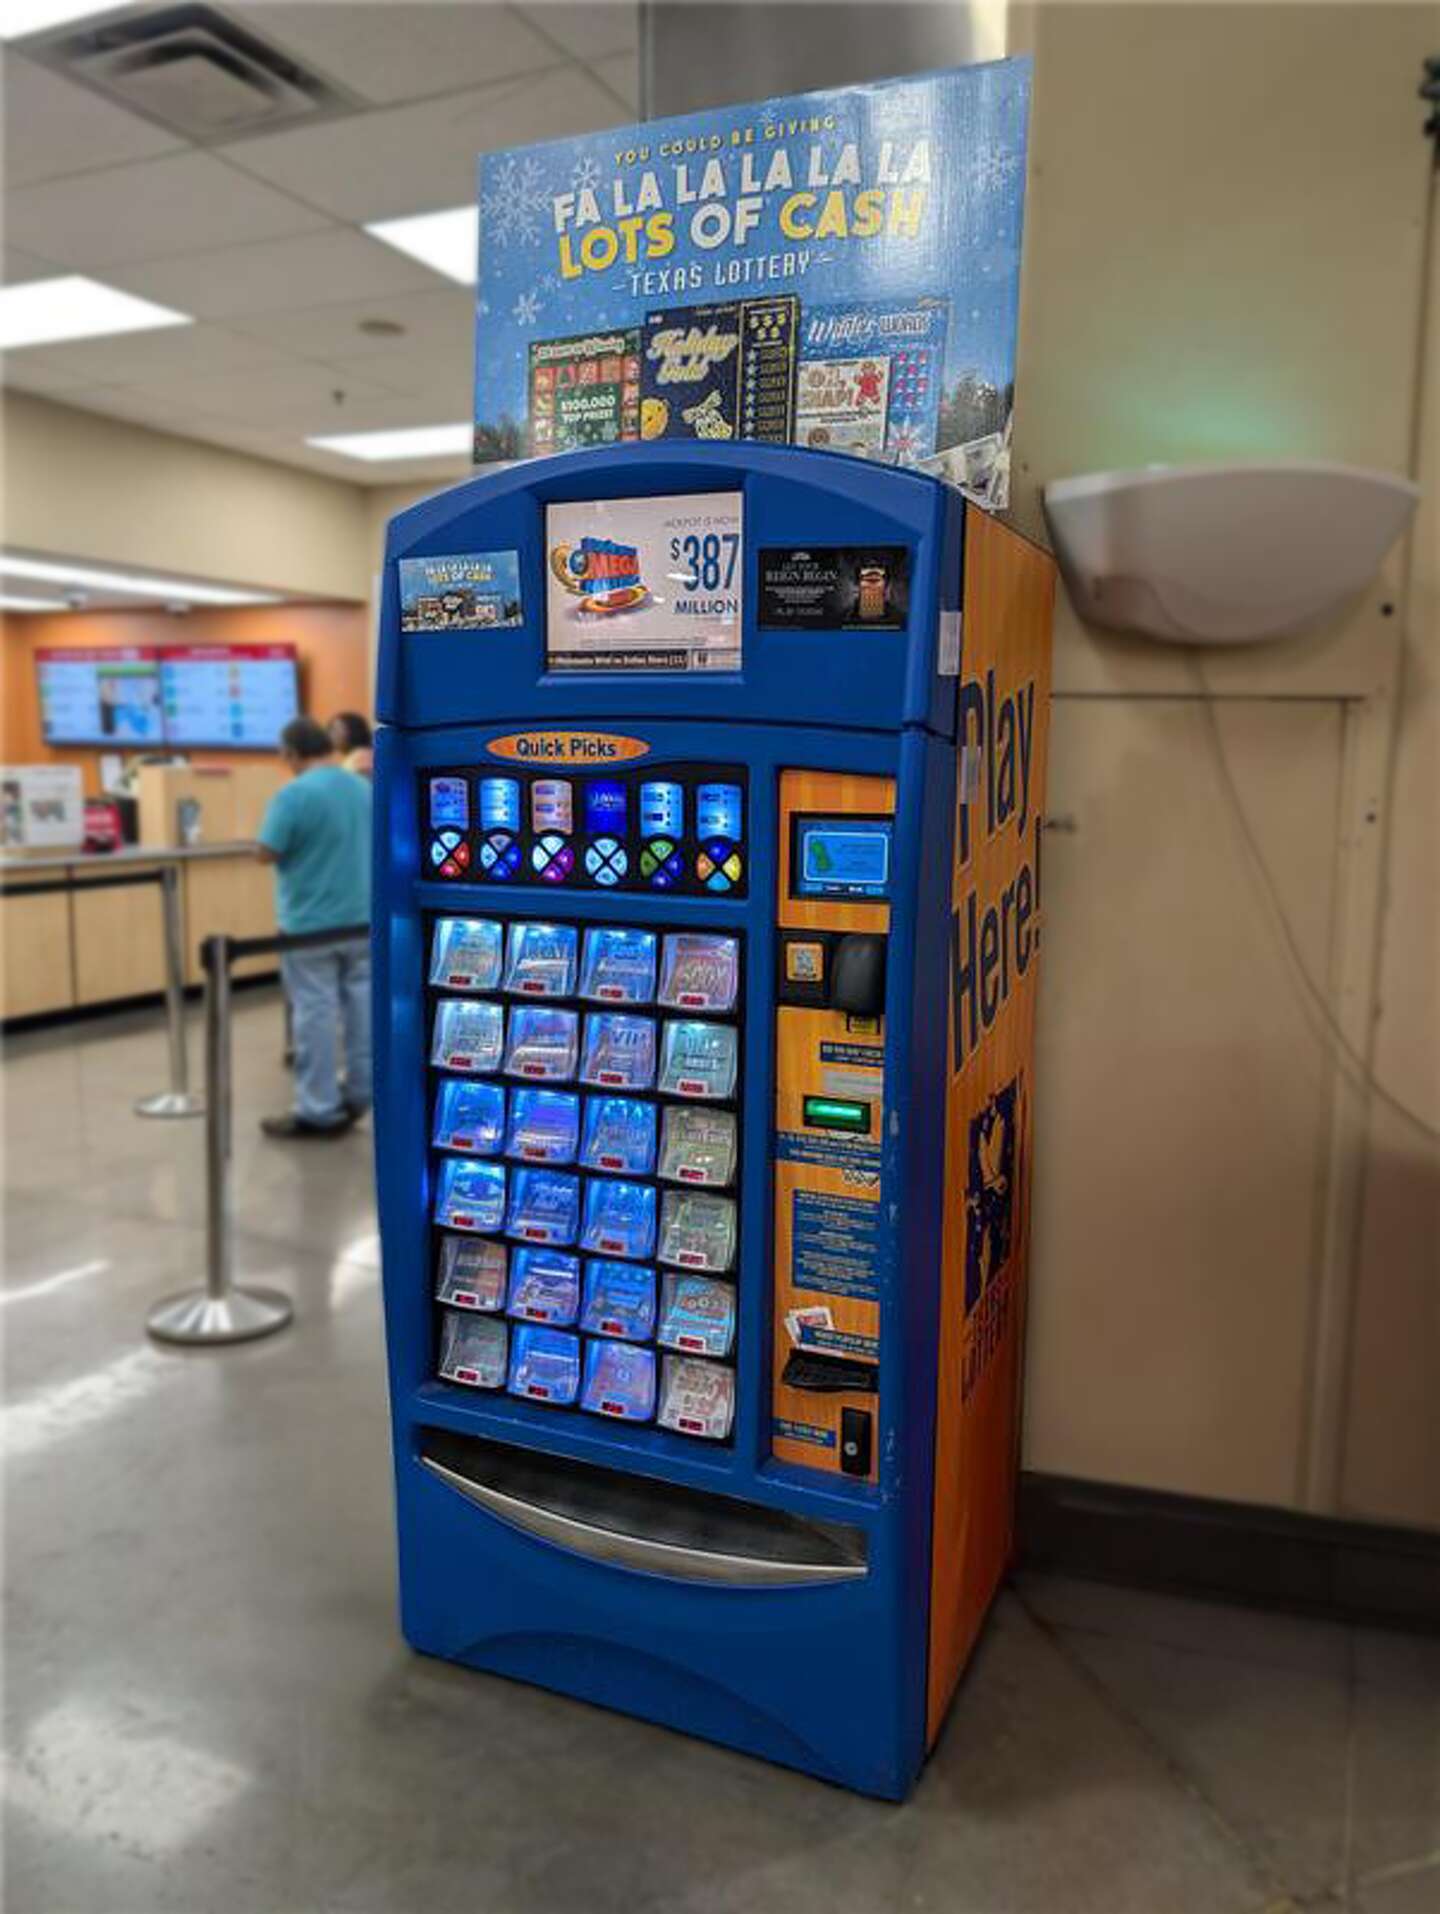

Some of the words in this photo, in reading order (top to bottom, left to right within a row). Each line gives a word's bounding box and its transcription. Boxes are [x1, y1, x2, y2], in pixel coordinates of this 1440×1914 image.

[614, 146, 649, 167] YOU
[659, 135, 722, 156] COULD
[731, 128, 753, 145] BE
[764, 115, 836, 140] GIVING
[553, 188, 601, 232] FA
[613, 171, 663, 215] LA
[676, 158, 726, 204] LA
[741, 149, 793, 192] LA
[808, 143, 862, 187] LA
[876, 139, 931, 184] LA
[559, 210, 675, 280] LOTS
[690, 196, 763, 249] OF
[779, 188, 925, 240] CASH
[631, 264, 702, 297] TEXAS
[714, 249, 811, 285] LOTTERY
[673, 599, 739, 615] MILLION
[516, 737, 565, 757] Quick
[570, 737, 617, 757] Picks
[960, 669, 1035, 866] Play
[953, 815, 1042, 1074] Here!
